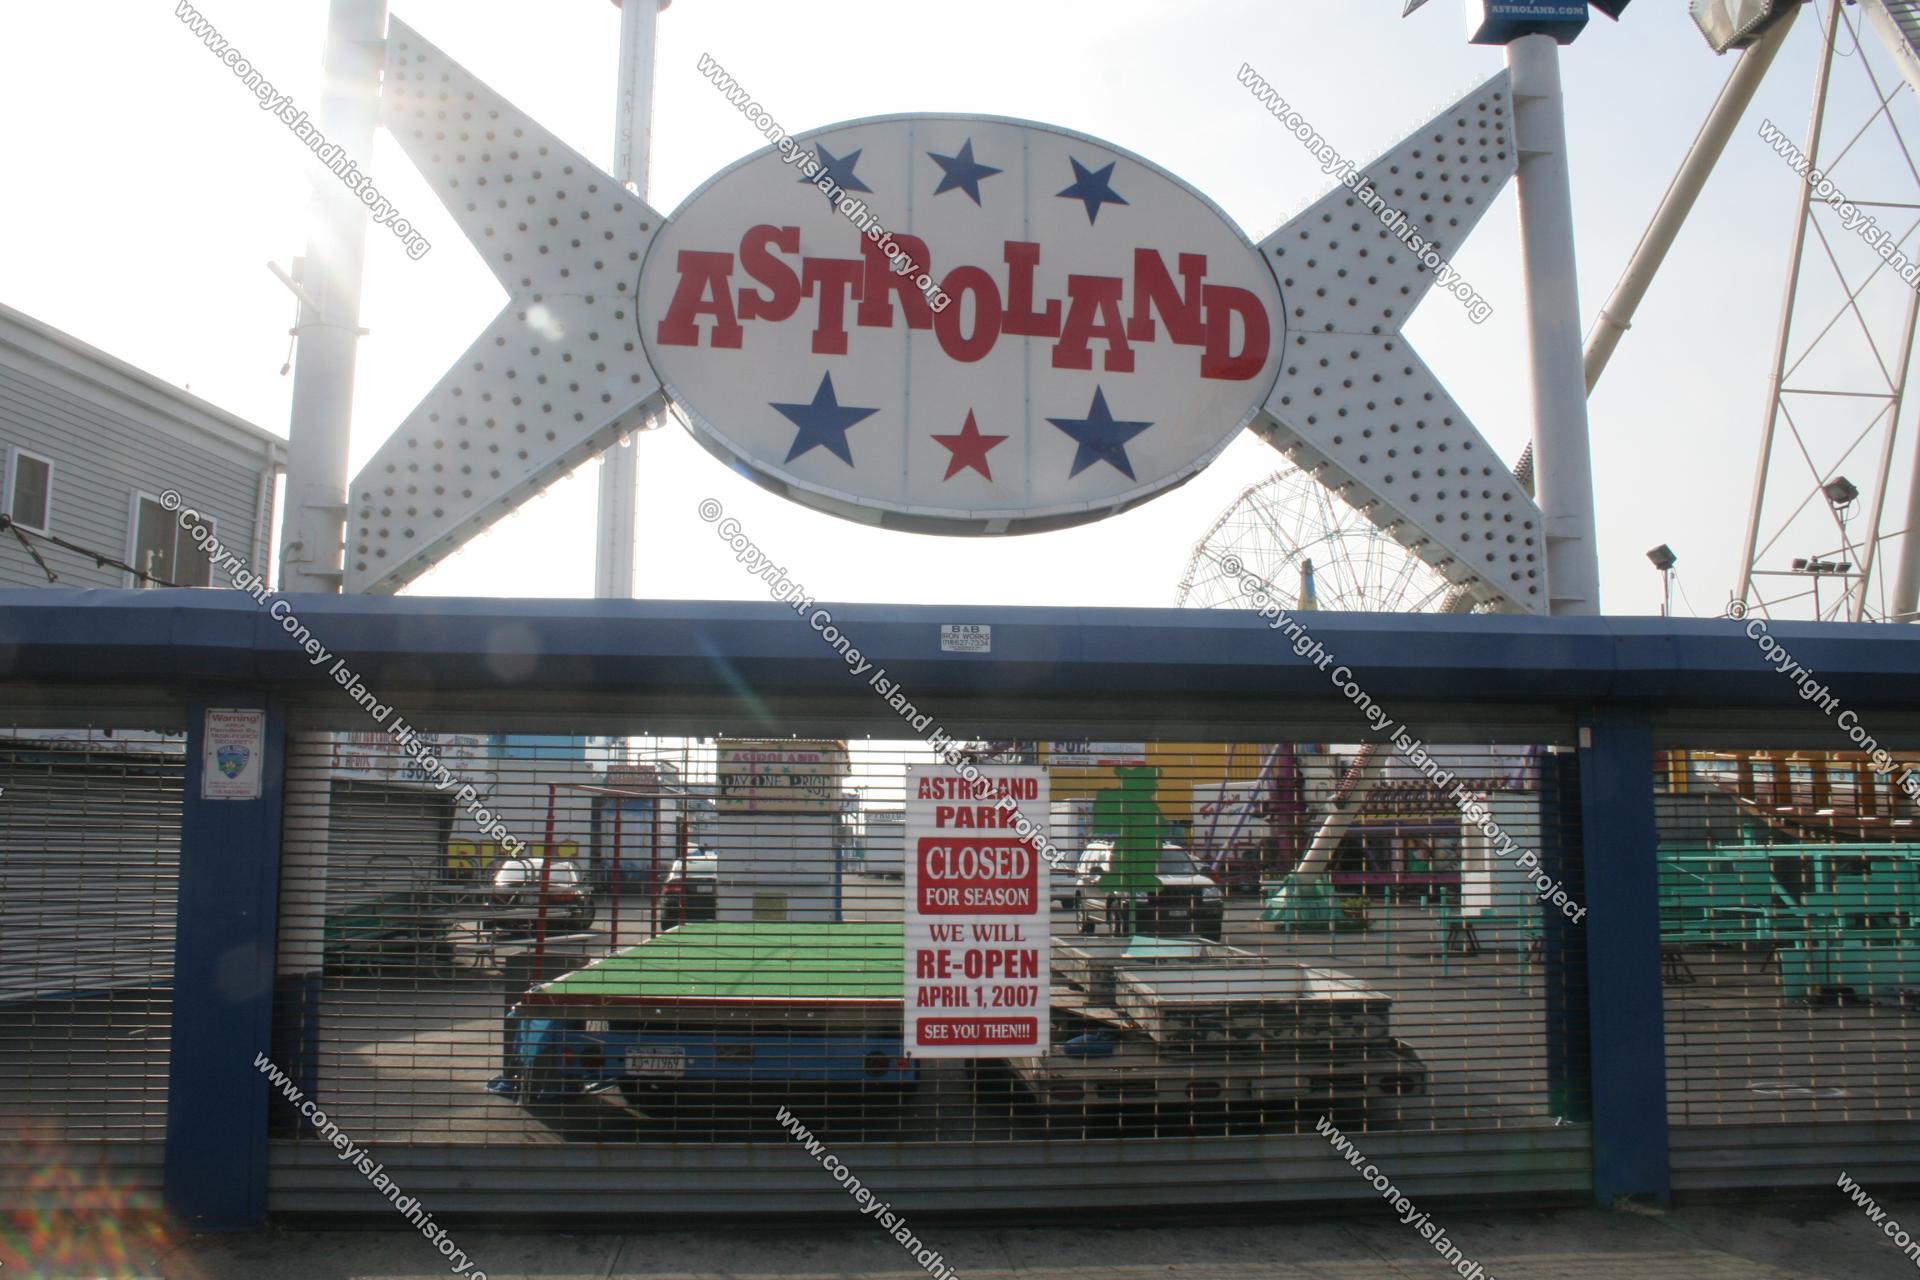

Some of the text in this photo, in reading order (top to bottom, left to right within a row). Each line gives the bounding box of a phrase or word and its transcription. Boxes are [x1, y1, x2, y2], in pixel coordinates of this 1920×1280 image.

[1492, 5, 1584, 15] ASTROLAND.COM
[657, 224, 1270, 381] ASTROLAND
[212, 714, 259, 724] Warning!
[719, 775, 749, 797] PAY
[751, 775, 784, 788] ONE
[789, 775, 832, 800] PRICE
[918, 777, 1038, 800] ASTROLAND
[936, 806, 1018, 829] PARK
[926, 847, 1030, 880] CLOSED
[926, 888, 1029, 906] FOR SEASON
[929, 924, 1026, 942] WE WILL
[916, 949, 1039, 979] RE-OPEN
[916, 985, 1039, 1009] APRIL 1, 2007
[924, 1023, 1030, 1039] SEE YOU THEN!!!
